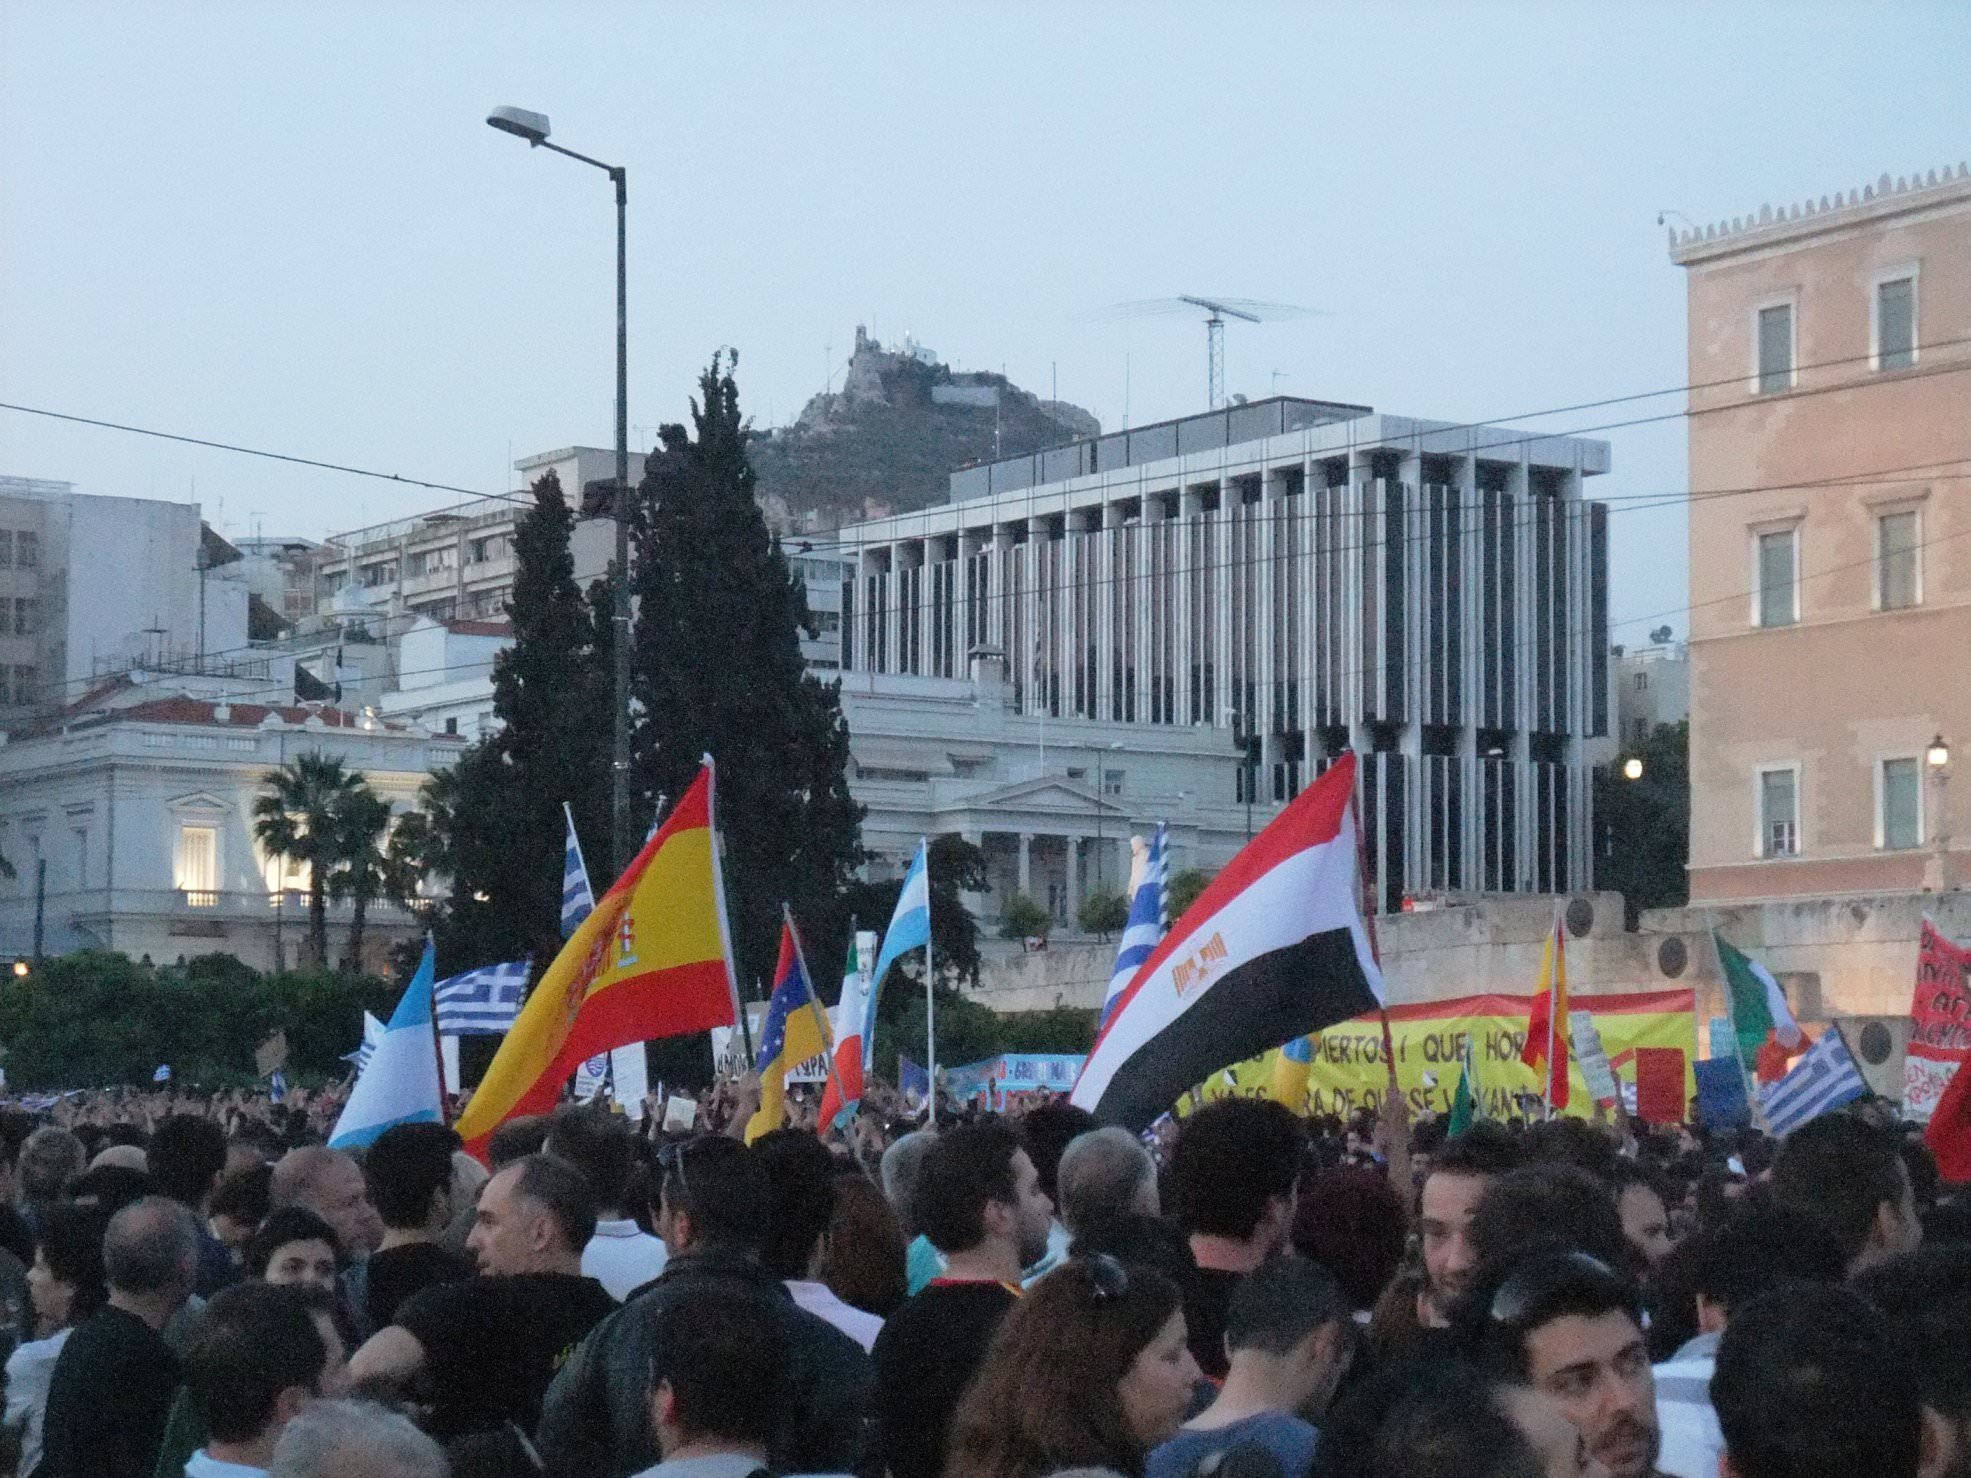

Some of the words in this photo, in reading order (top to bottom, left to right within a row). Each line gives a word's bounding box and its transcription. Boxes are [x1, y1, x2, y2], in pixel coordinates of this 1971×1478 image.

[1321, 1034, 1391, 1064] IERTOS
[1422, 1031, 1468, 1064] QUE
[1485, 1030, 1527, 1063] HOR
